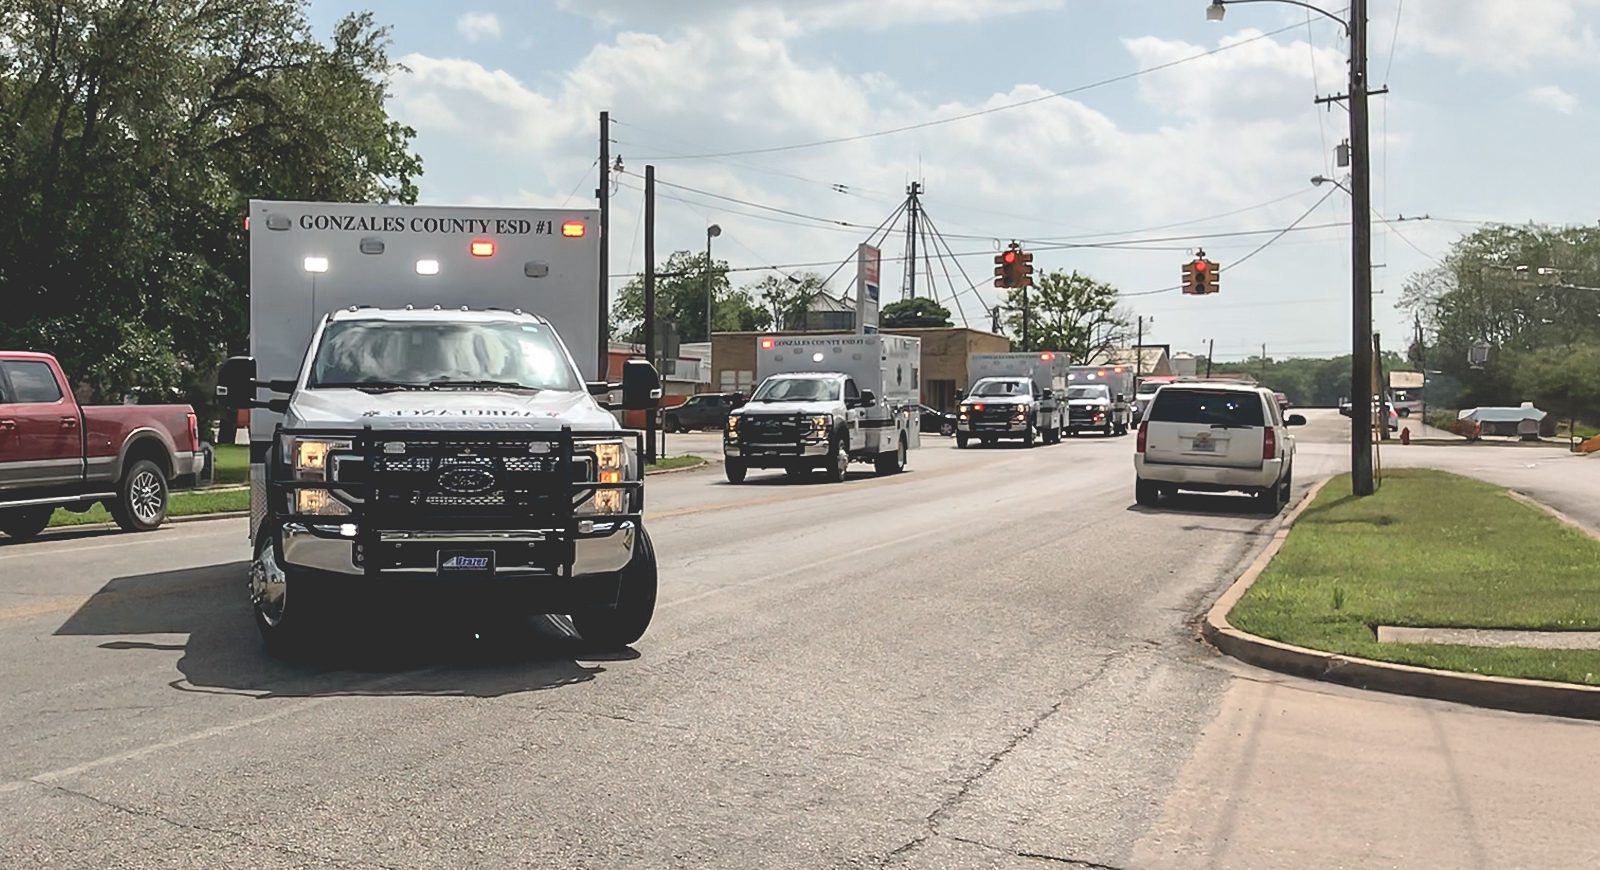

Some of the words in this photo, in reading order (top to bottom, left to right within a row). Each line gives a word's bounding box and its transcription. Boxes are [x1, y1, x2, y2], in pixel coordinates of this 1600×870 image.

[300, 214, 405, 232] GONZALES
[410, 217, 490, 234] COUNTY
[495, 219, 531, 234] ESD
[535, 220, 553, 235] #1
[478, 421, 539, 430] DUTY
